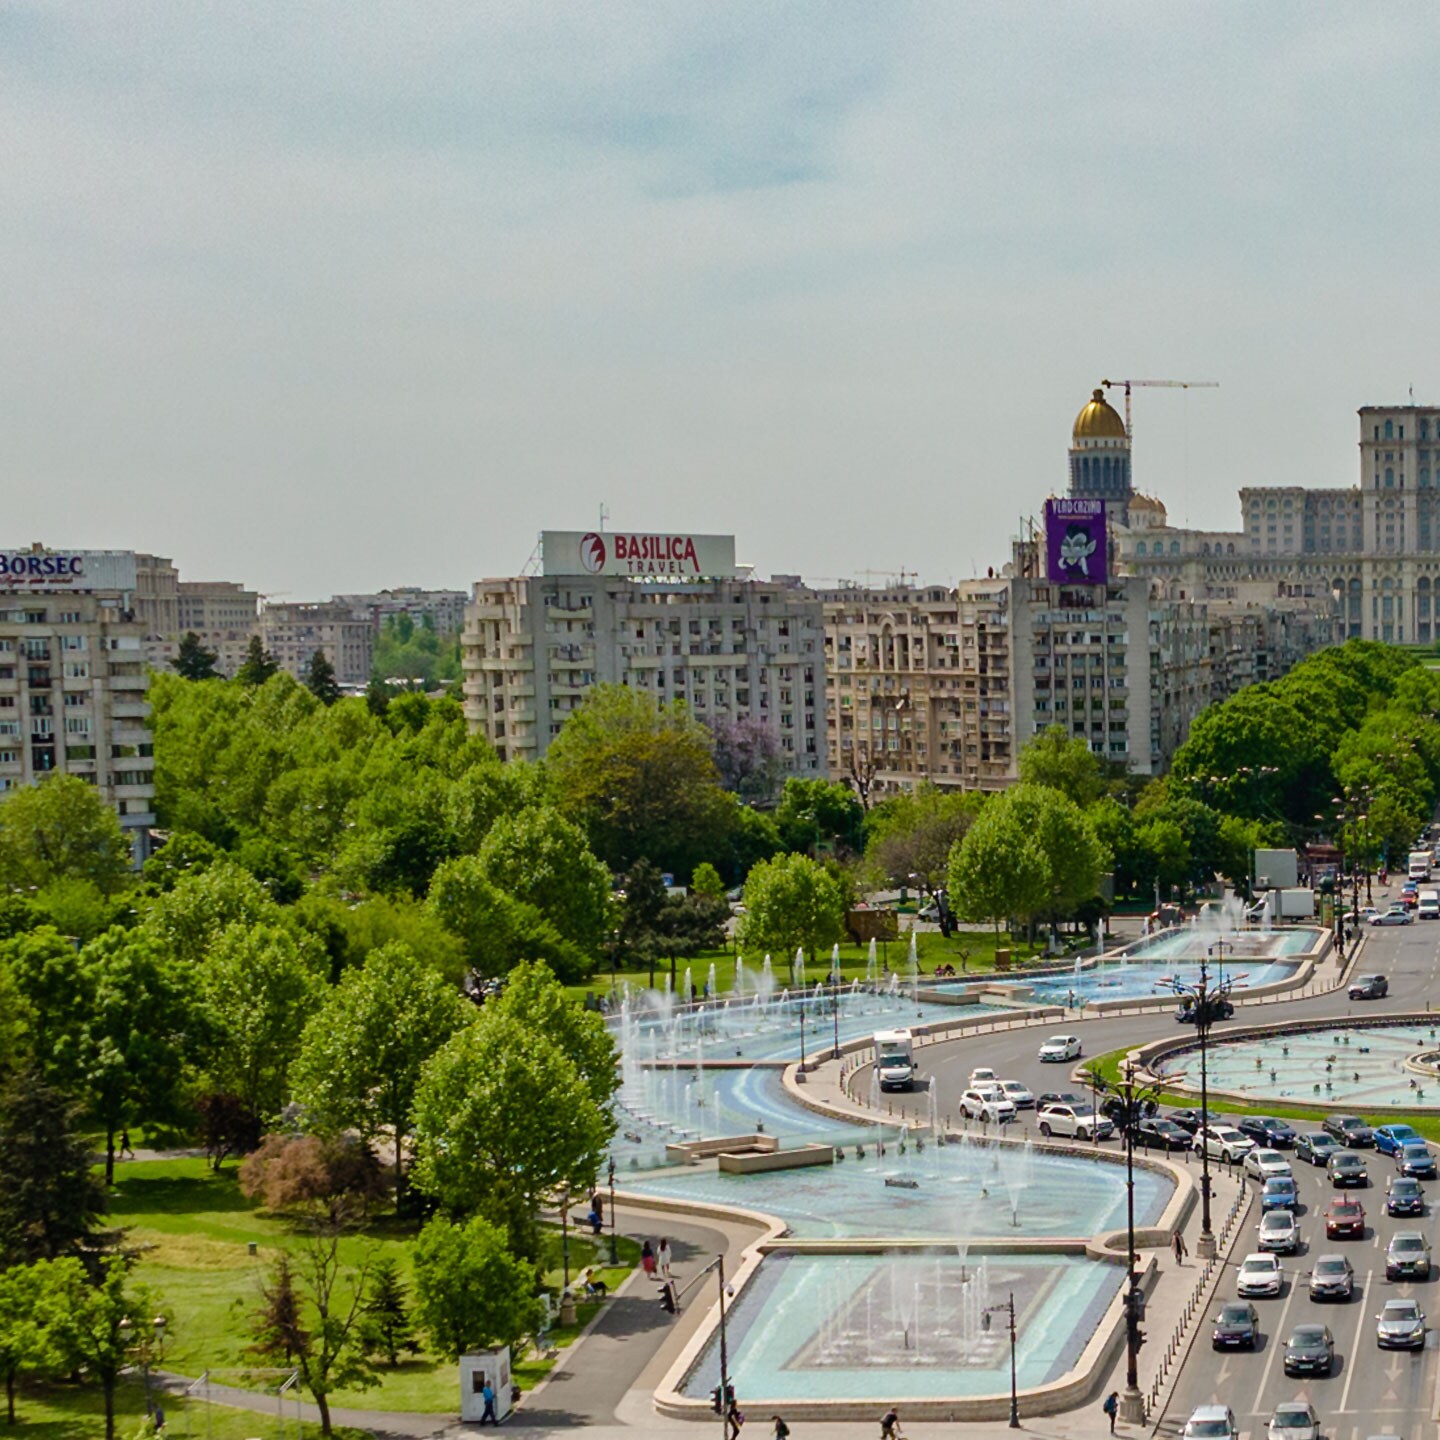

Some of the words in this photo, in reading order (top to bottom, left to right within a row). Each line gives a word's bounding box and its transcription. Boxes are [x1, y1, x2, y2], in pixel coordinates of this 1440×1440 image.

[0, 554, 83, 575] BORSEC
[614, 535, 701, 573] BASILICA
[627, 560, 685, 573] TRAVEL
